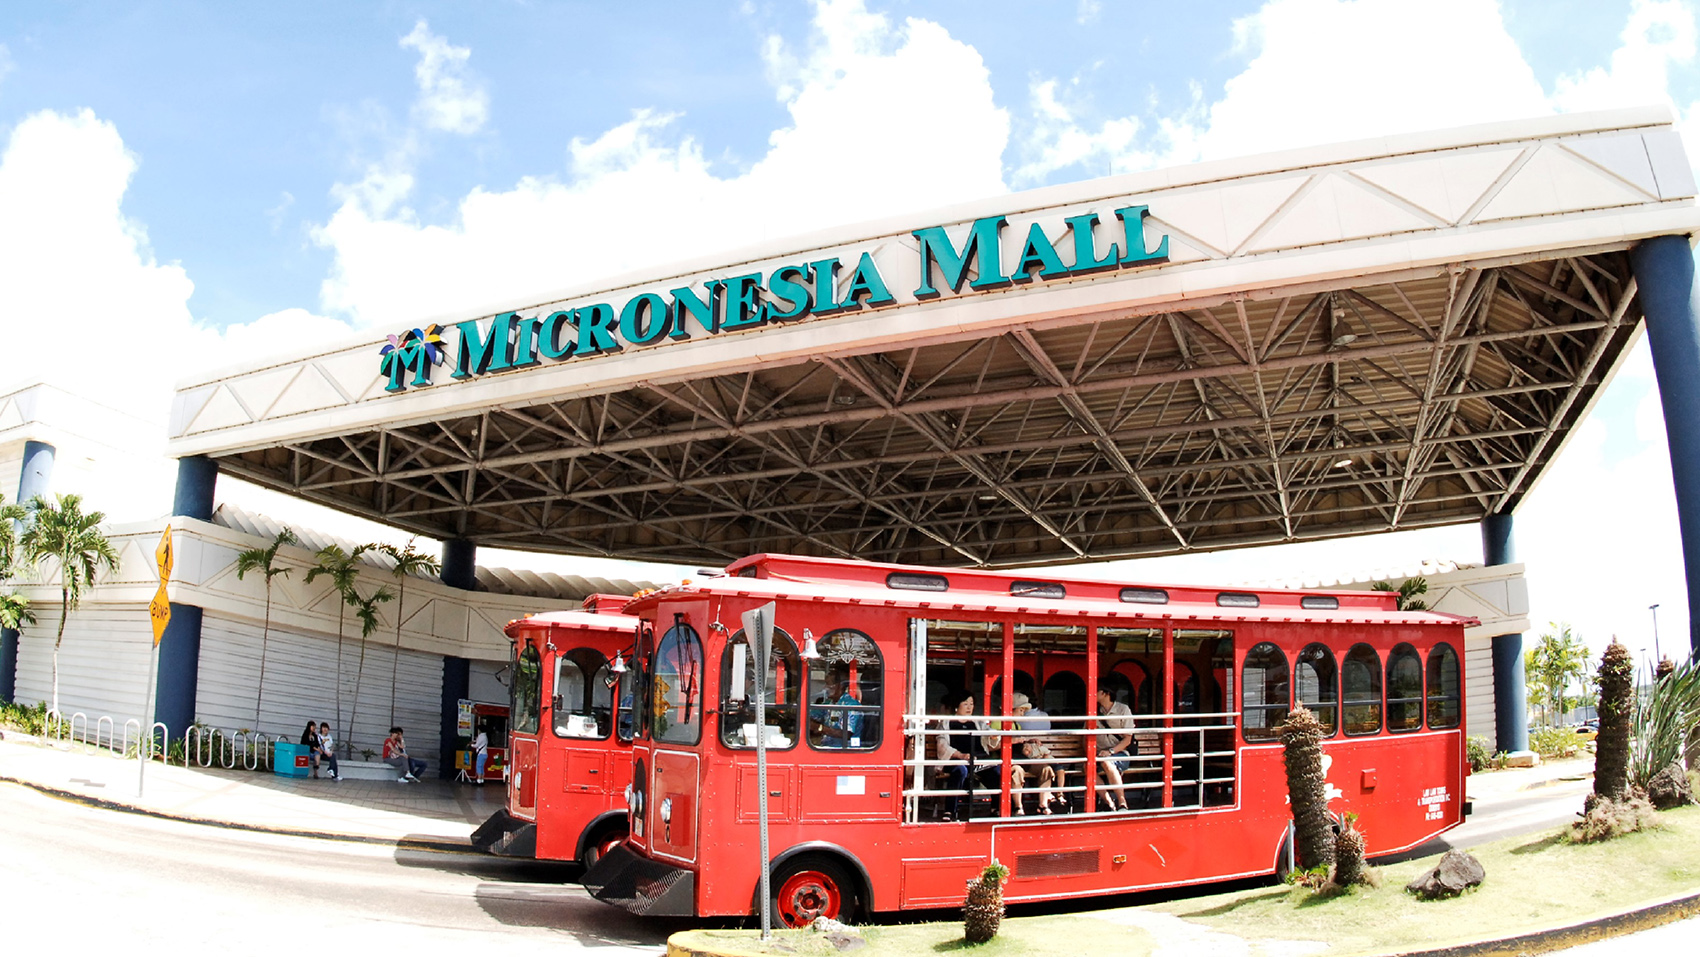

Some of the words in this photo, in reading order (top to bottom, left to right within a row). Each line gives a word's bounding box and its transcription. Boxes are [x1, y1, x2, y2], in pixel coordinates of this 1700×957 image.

[451, 253, 898, 381] MICRONESIA
[912, 203, 1171, 300] MALL
[152, 601, 168, 620] BUMP
